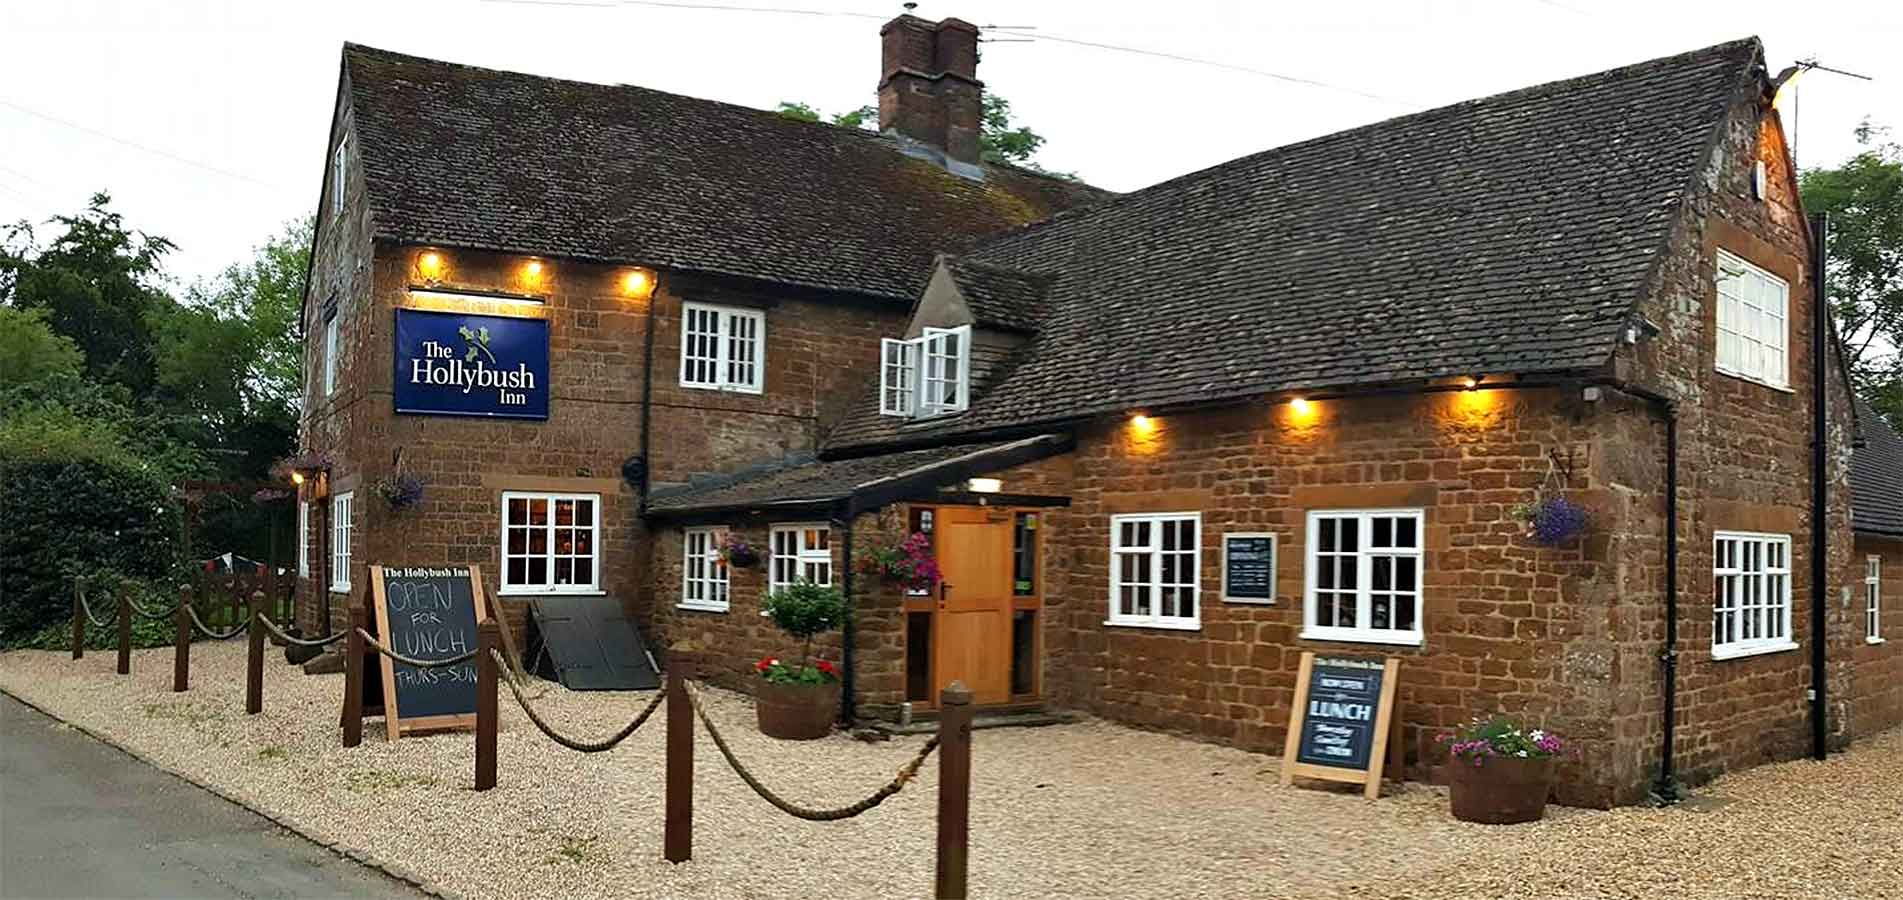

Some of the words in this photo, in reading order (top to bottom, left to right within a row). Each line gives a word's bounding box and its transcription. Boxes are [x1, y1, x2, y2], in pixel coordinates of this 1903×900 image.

[422, 341, 453, 359] The
[410, 358, 535, 394] Hollybush
[500, 389, 526, 405] Inn
[384, 567, 402, 577] The
[404, 567, 451, 580] Hollybush
[453, 567, 469, 577] Inn
[388, 580, 452, 611] OPEN
[411, 612, 442, 626] FOR
[392, 629, 469, 656] LUNCH
[1310, 700, 1372, 721] LUNCH
